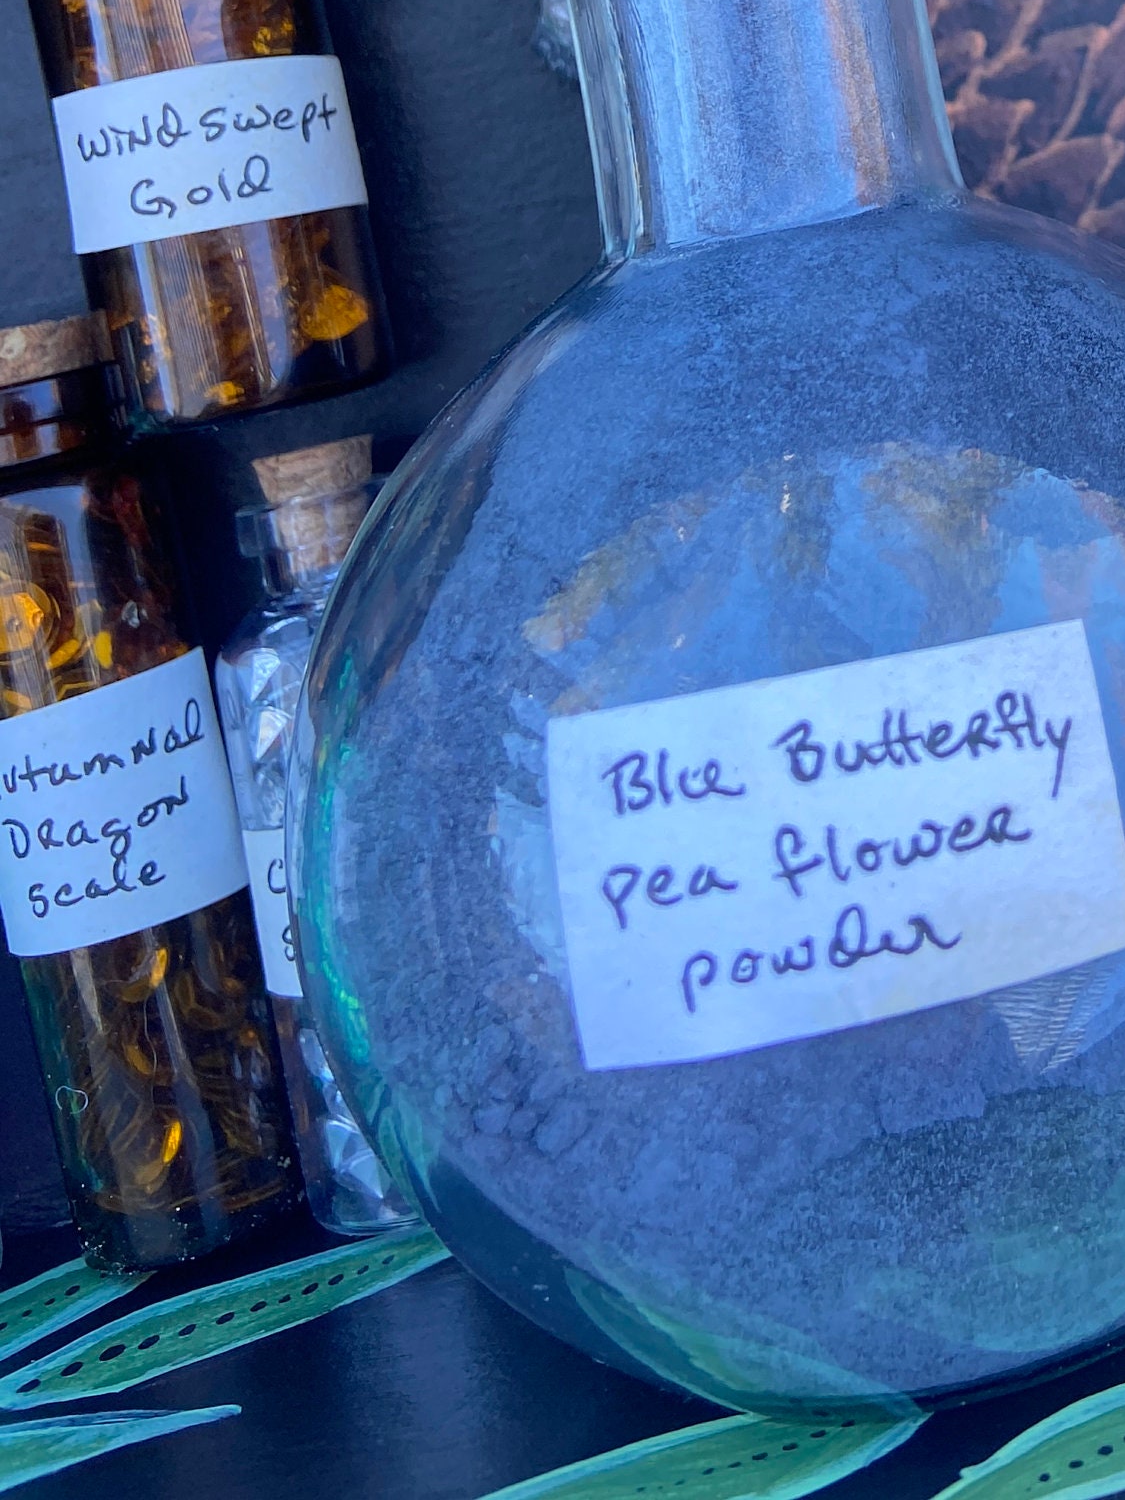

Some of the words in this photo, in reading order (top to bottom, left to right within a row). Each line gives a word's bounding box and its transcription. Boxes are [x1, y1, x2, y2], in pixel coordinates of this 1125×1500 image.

[129, 155, 273, 219] Gold
[0, 699, 204, 796] utumnal
[769, 690, 1073, 798] Butterfly
[2, 775, 190, 859] Dragon
